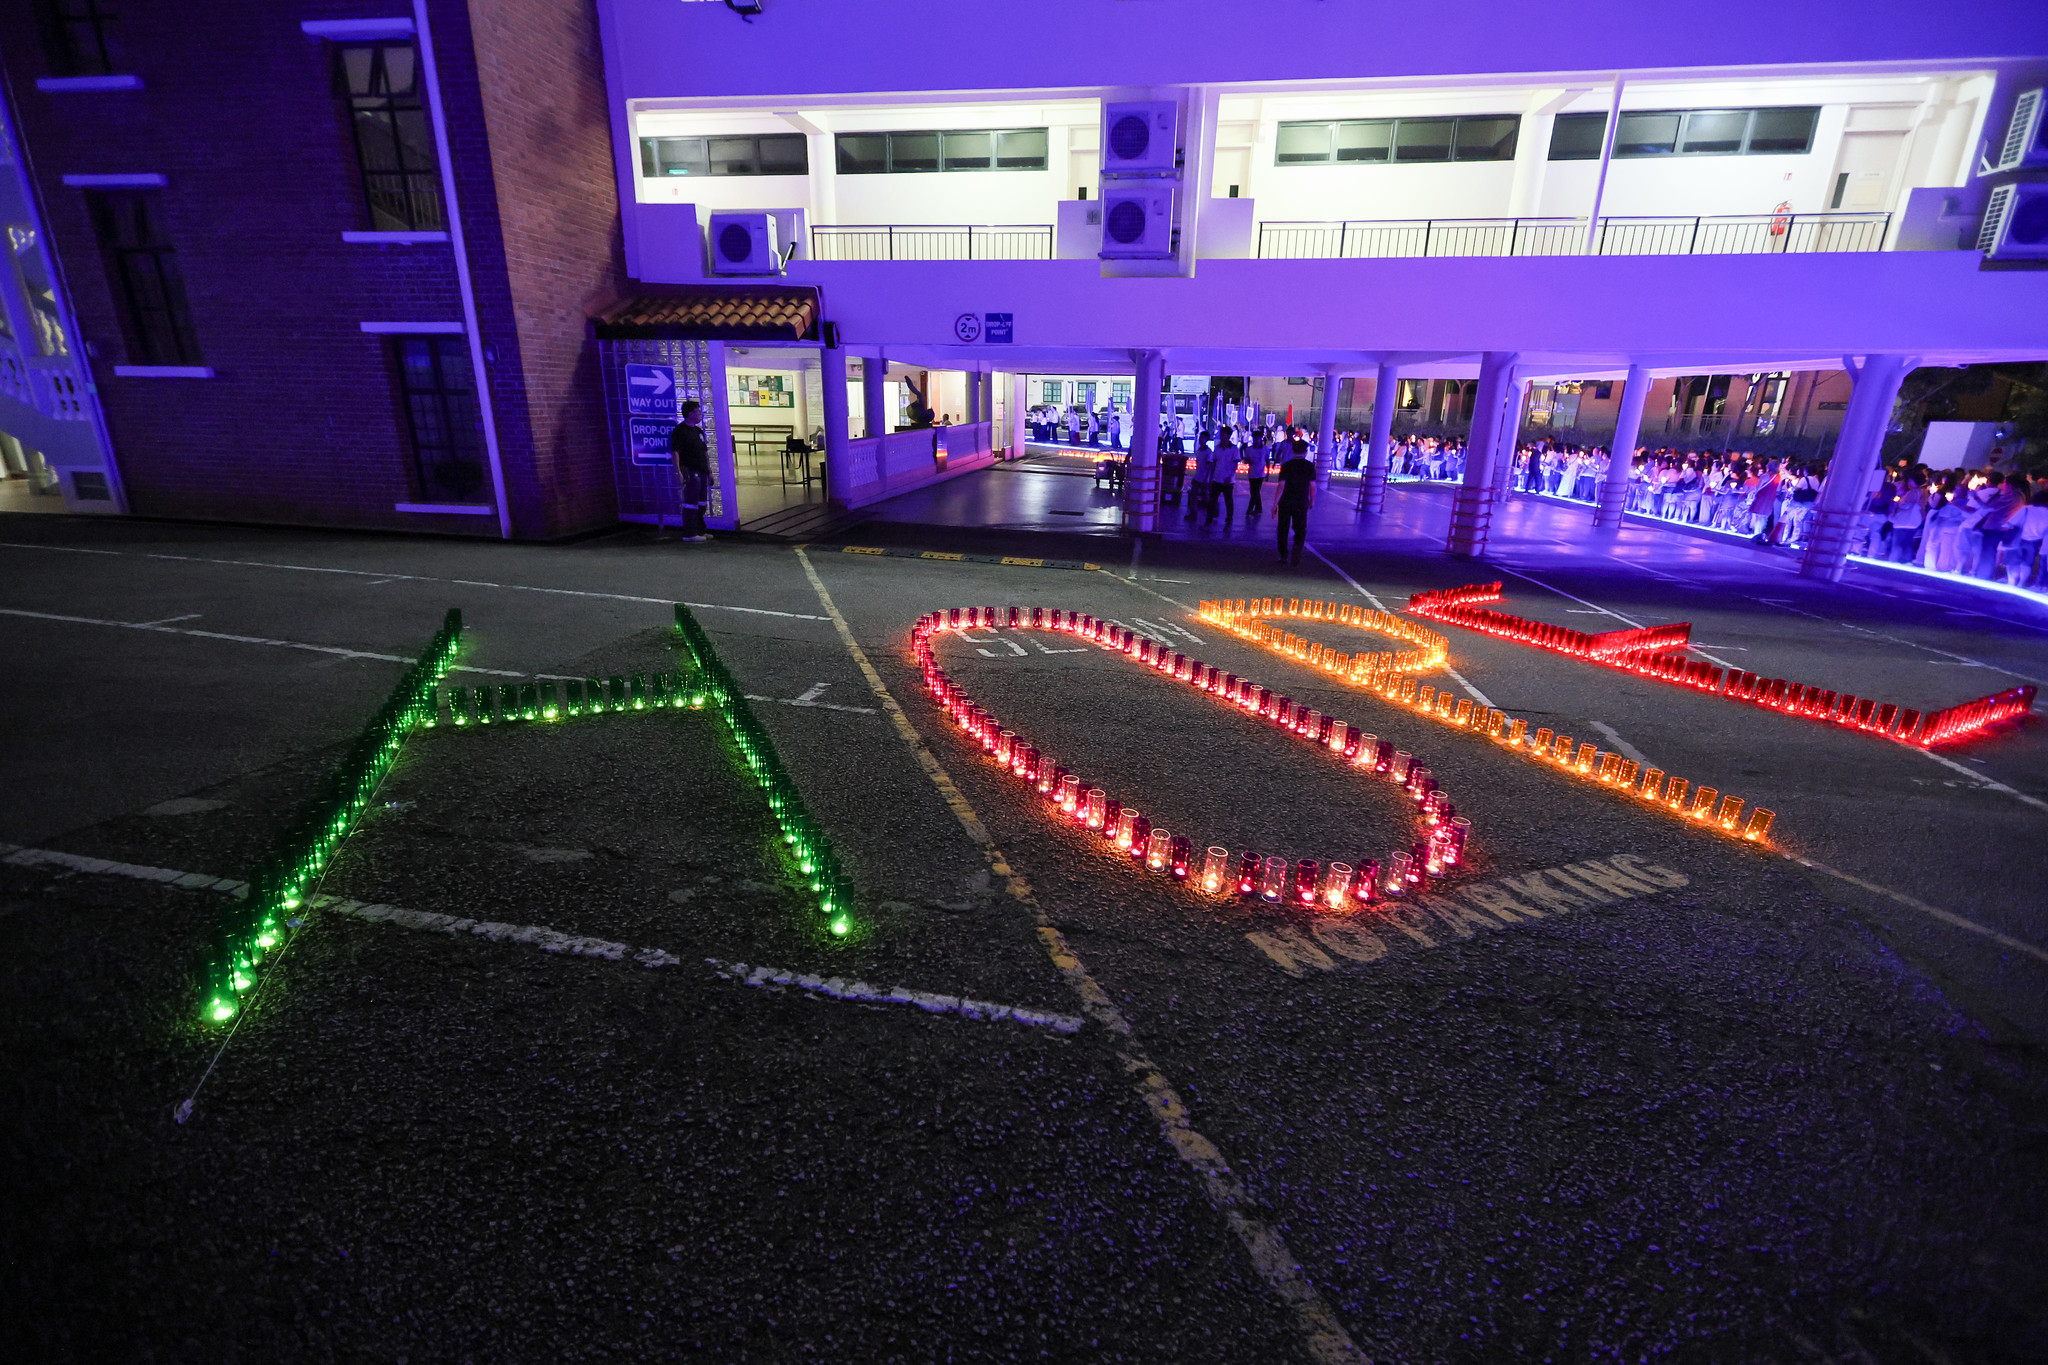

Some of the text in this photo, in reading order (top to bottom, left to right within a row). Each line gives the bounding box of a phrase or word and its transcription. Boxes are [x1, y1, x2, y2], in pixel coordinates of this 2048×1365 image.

[631, 398, 675, 408] WAY OUT
[643, 437, 668, 447] POINT
[955, 616, 1206, 658] SLW
[1245, 854, 1689, 978] NO PARKING
